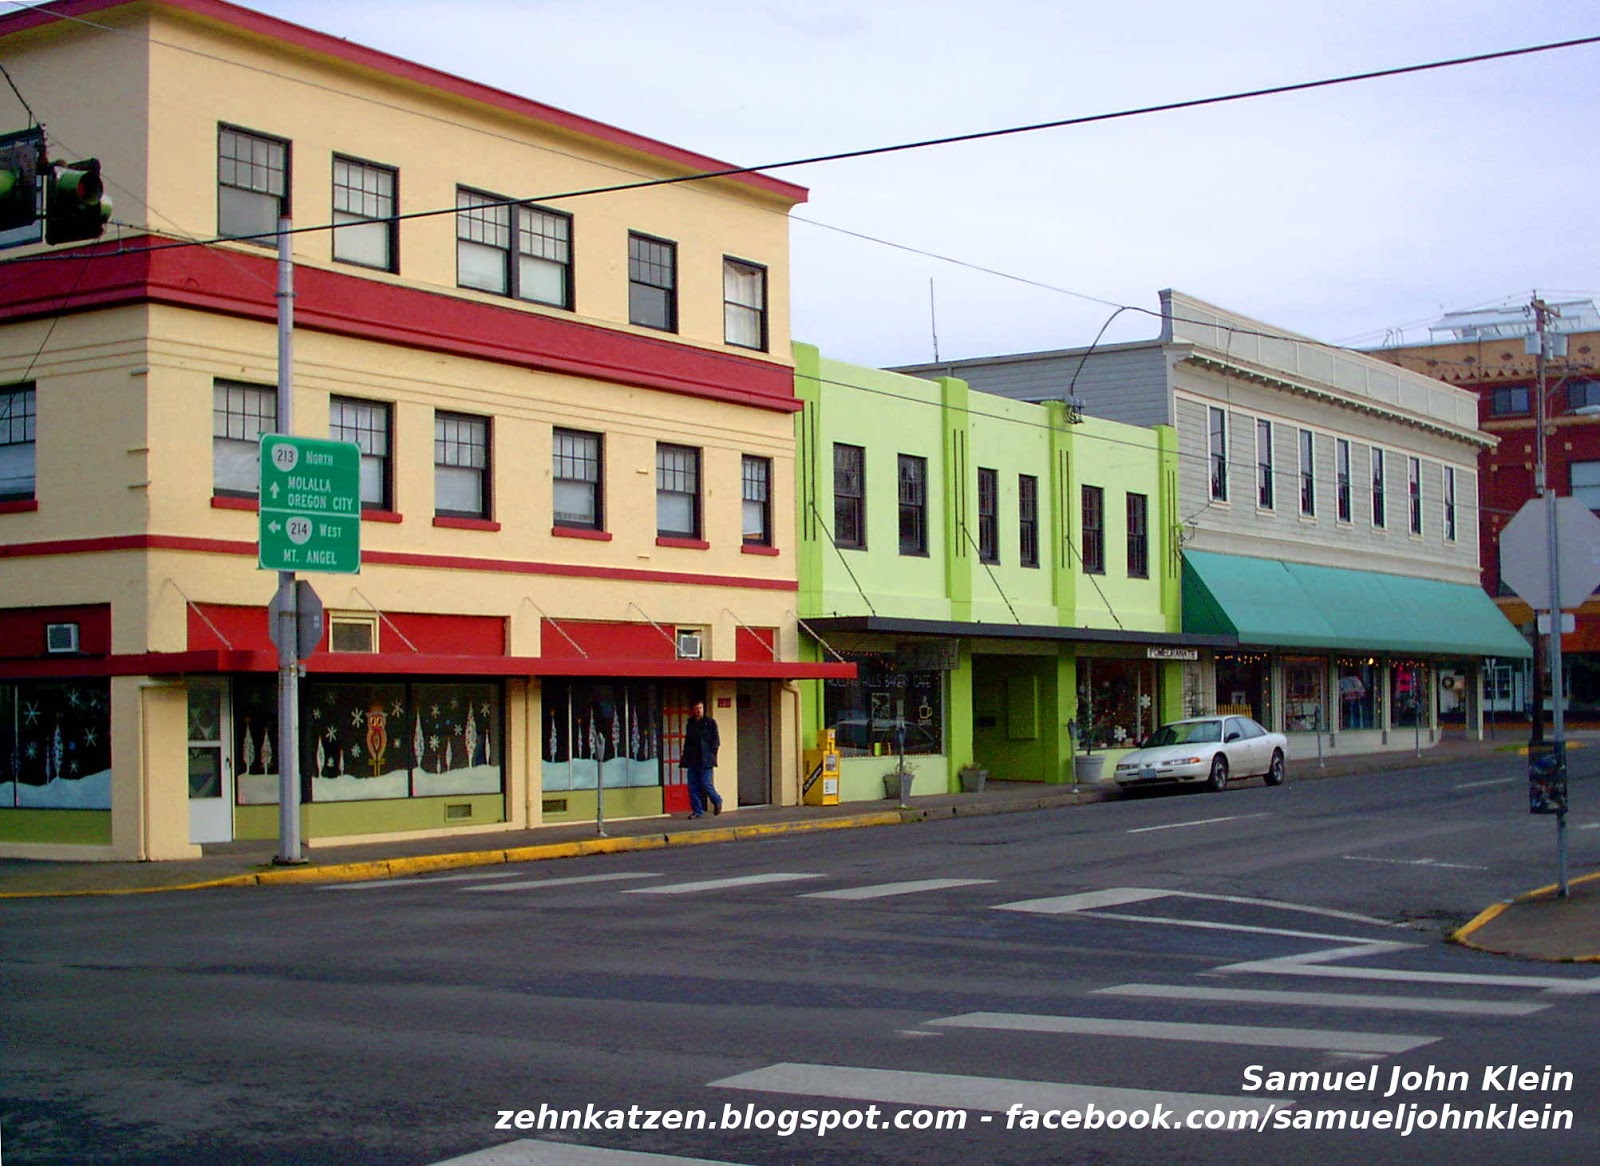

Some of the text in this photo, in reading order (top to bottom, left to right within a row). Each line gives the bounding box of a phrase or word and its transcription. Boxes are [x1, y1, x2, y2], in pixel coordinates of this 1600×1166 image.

[277, 449, 334, 467] 213 NORTH
[287, 475, 332, 493] MOLALLA
[287, 493, 353, 511] OREGON CITY
[291, 522, 342, 538] 214 WEST
[283, 548, 337, 565] MT. ANGEL
